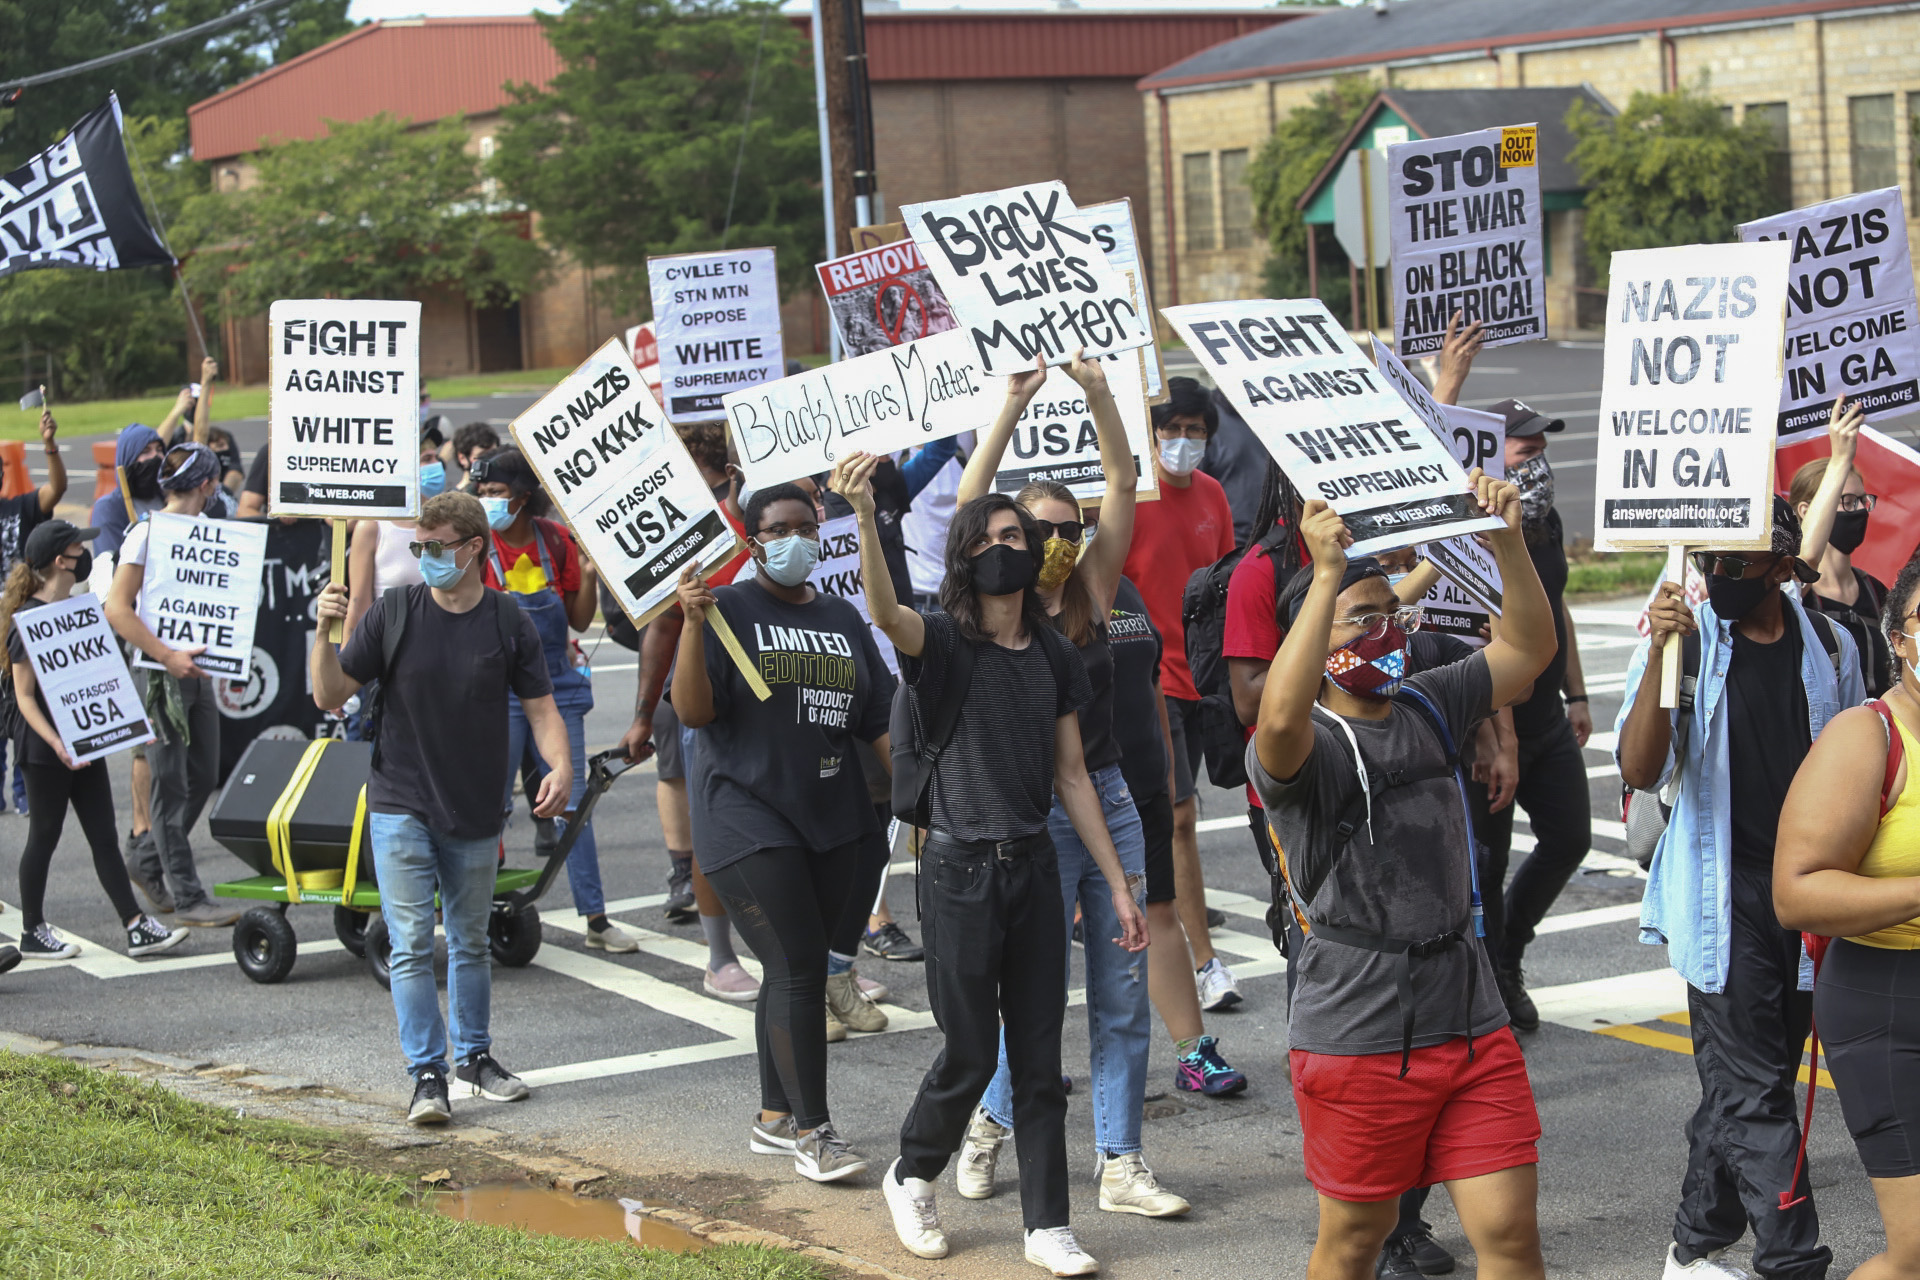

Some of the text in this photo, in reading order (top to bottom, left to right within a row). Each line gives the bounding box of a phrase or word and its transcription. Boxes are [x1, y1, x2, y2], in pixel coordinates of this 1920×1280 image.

[1502, 149, 1535, 163] NOW
[1505, 136, 1532, 150] OUT
[1405, 188, 1527, 243] THE WAR
[1758, 208, 1889, 263] AZIS
[728, 260, 752, 274] TO
[980, 256, 1098, 306] LIVES
[1405, 239, 1528, 295] ON BLACK
[674, 284, 749, 304] STN MTN
[1621, 275, 1757, 323] NAZIS
[1786, 256, 1880, 318] NOT
[681, 308, 747, 326] OPPOSE
[1402, 279, 1533, 337] AMERICA!
[283, 319, 407, 357] FIGHT
[675, 338, 763, 365] WHITE
[1188, 314, 1344, 365] FIGHT
[1629, 333, 1740, 386] NOT
[1787, 347, 1897, 401] IN GA
[285, 369, 405, 394] AGAINST
[674, 368, 768, 388] SUPREMACY
[1242, 367, 1379, 407] AGAINST
[532, 366, 630, 455] NO NAZIS
[732, 384, 835, 463] Black
[823, 374, 901, 438] Lives
[1033, 398, 1092, 419] FASCI
[1428, 404, 1447, 434] TO
[1611, 407, 1752, 436] WELCOME
[292, 416, 394, 445] WHITE
[1012, 419, 1100, 459] USA
[1286, 419, 1422, 464] WHITE
[553, 401, 655, 494] NO KKK
[286, 455, 398, 474] SUPREMACY
[1622, 447, 1731, 488] IN GA
[308, 486, 375, 500] PSLWEB.ORG
[595, 462, 675, 533] NO FASCIST
[1317, 463, 1449, 501] SUPREMACY
[613, 496, 688, 559] USA
[1372, 502, 1453, 527] PSLWEB.ORG
[1612, 505, 1743, 523] answercoalition.org
[188, 525, 227, 544] ALL
[171, 544, 240, 567] RACES
[649, 531, 703, 578] PSLWEB.ORG
[176, 567, 229, 589] UNITE
[26, 607, 100, 643] NO NAZIS
[158, 597, 240, 620] AGAINST
[1109, 613, 1152, 635] TERREY
[1420, 613, 1471, 628] SLWEB.ORG
[156, 617, 234, 648] HATE
[754, 622, 853, 658] LIMITED
[37, 635, 111, 675] NO KKK
[759, 652, 856, 690] EDITION
[60, 678, 121, 707] NO FASCIST
[802, 687, 853, 711] PRODUCT
[72, 698, 125, 731] USA
[819, 709, 849, 729] HOPE
